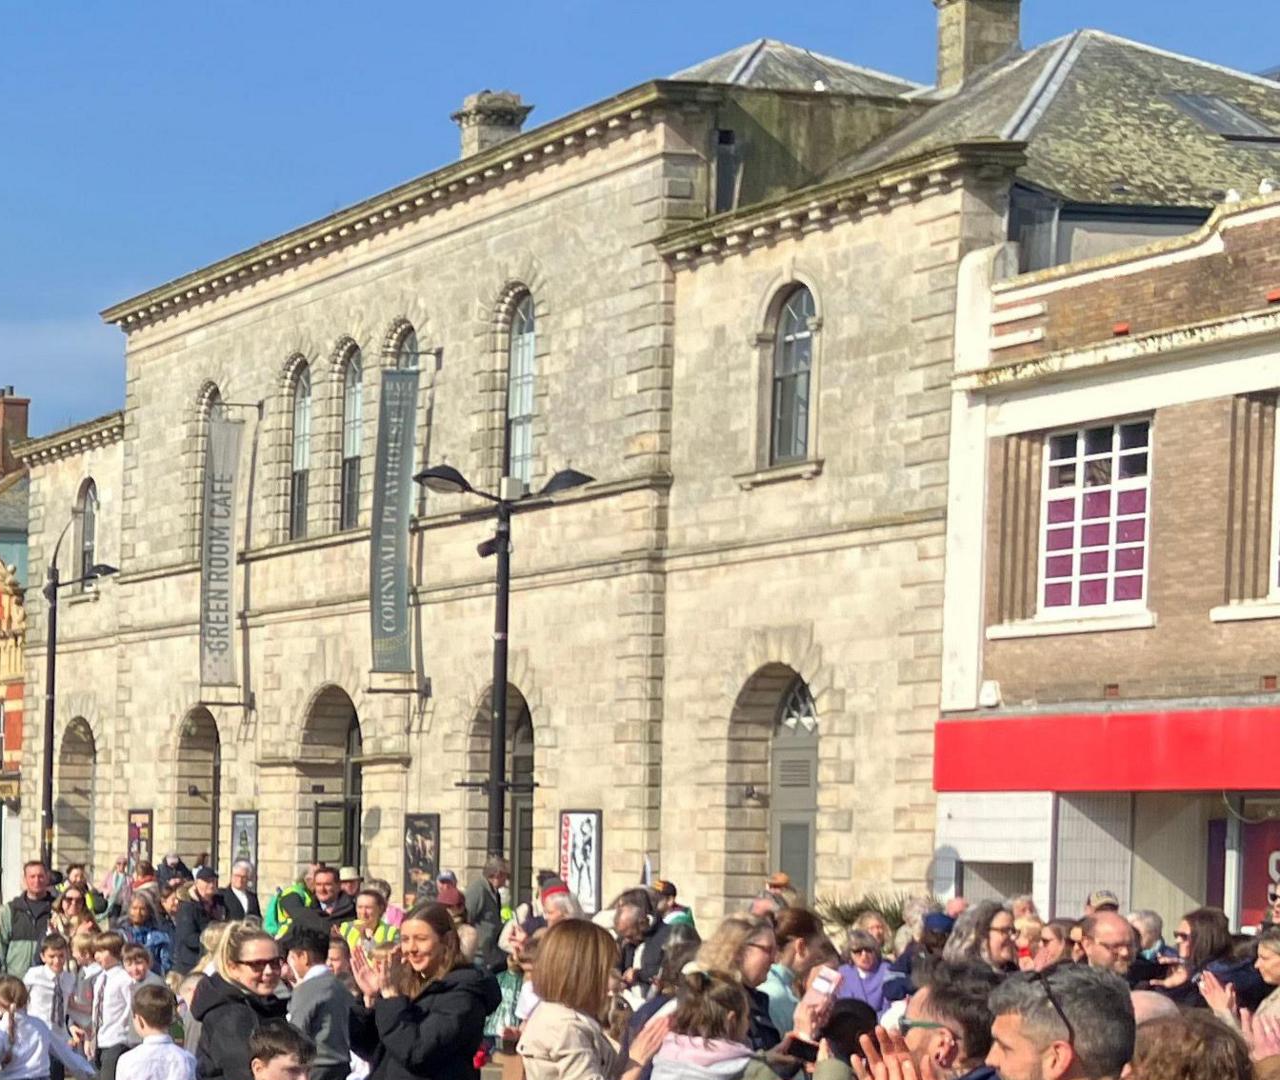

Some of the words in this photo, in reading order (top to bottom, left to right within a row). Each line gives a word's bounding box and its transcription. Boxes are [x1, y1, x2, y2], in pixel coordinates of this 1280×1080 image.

[207, 526, 230, 582] ROOM
[380, 529, 397, 633] CORNWALL
[205, 589, 229, 655] GREEN
[562, 815, 570, 882] HICAGO
